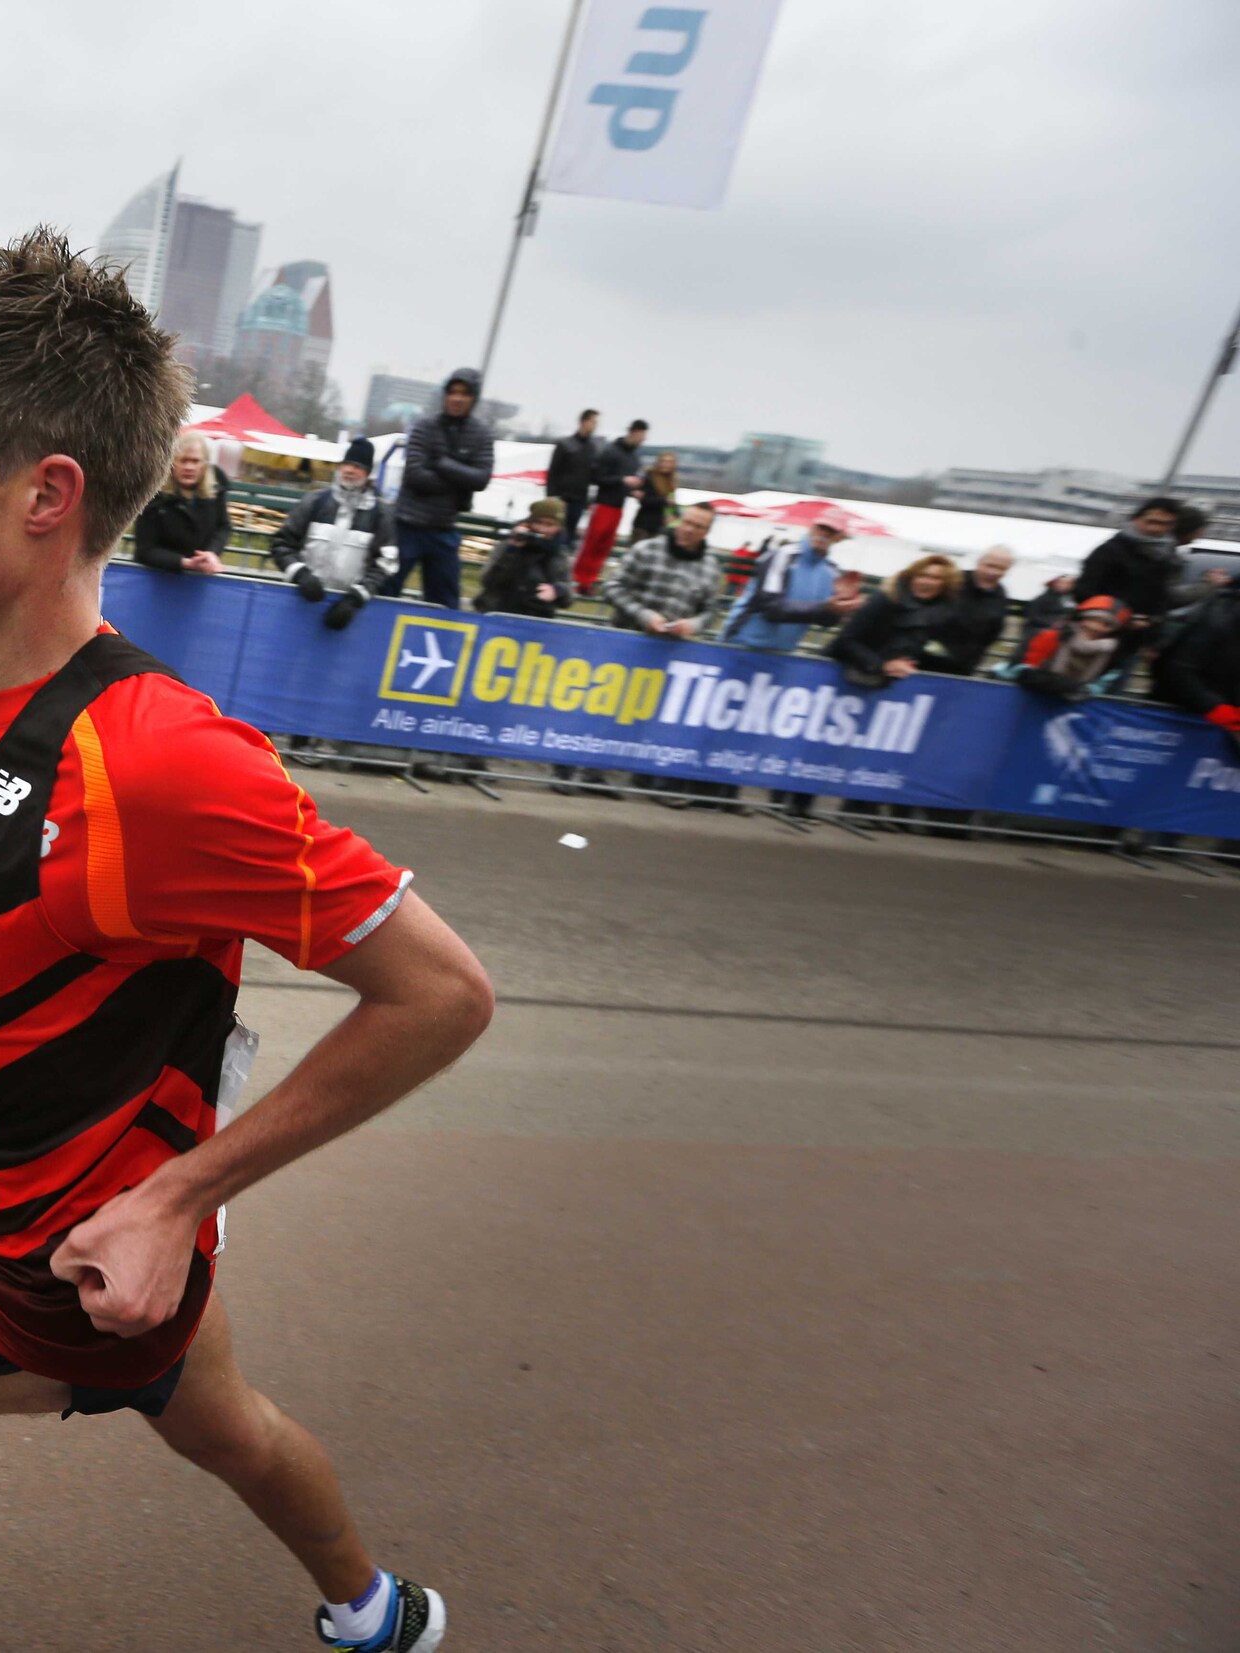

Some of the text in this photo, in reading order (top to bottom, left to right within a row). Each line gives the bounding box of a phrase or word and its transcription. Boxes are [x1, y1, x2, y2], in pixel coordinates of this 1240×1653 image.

[471, 635, 935, 754] CheapTickets.nl
[371, 707, 416, 733] Alle
[419, 714, 494, 744] airline,
[497, 723, 541, 747] alle
[760, 754, 788, 776] de
[788, 758, 847, 784] beste
